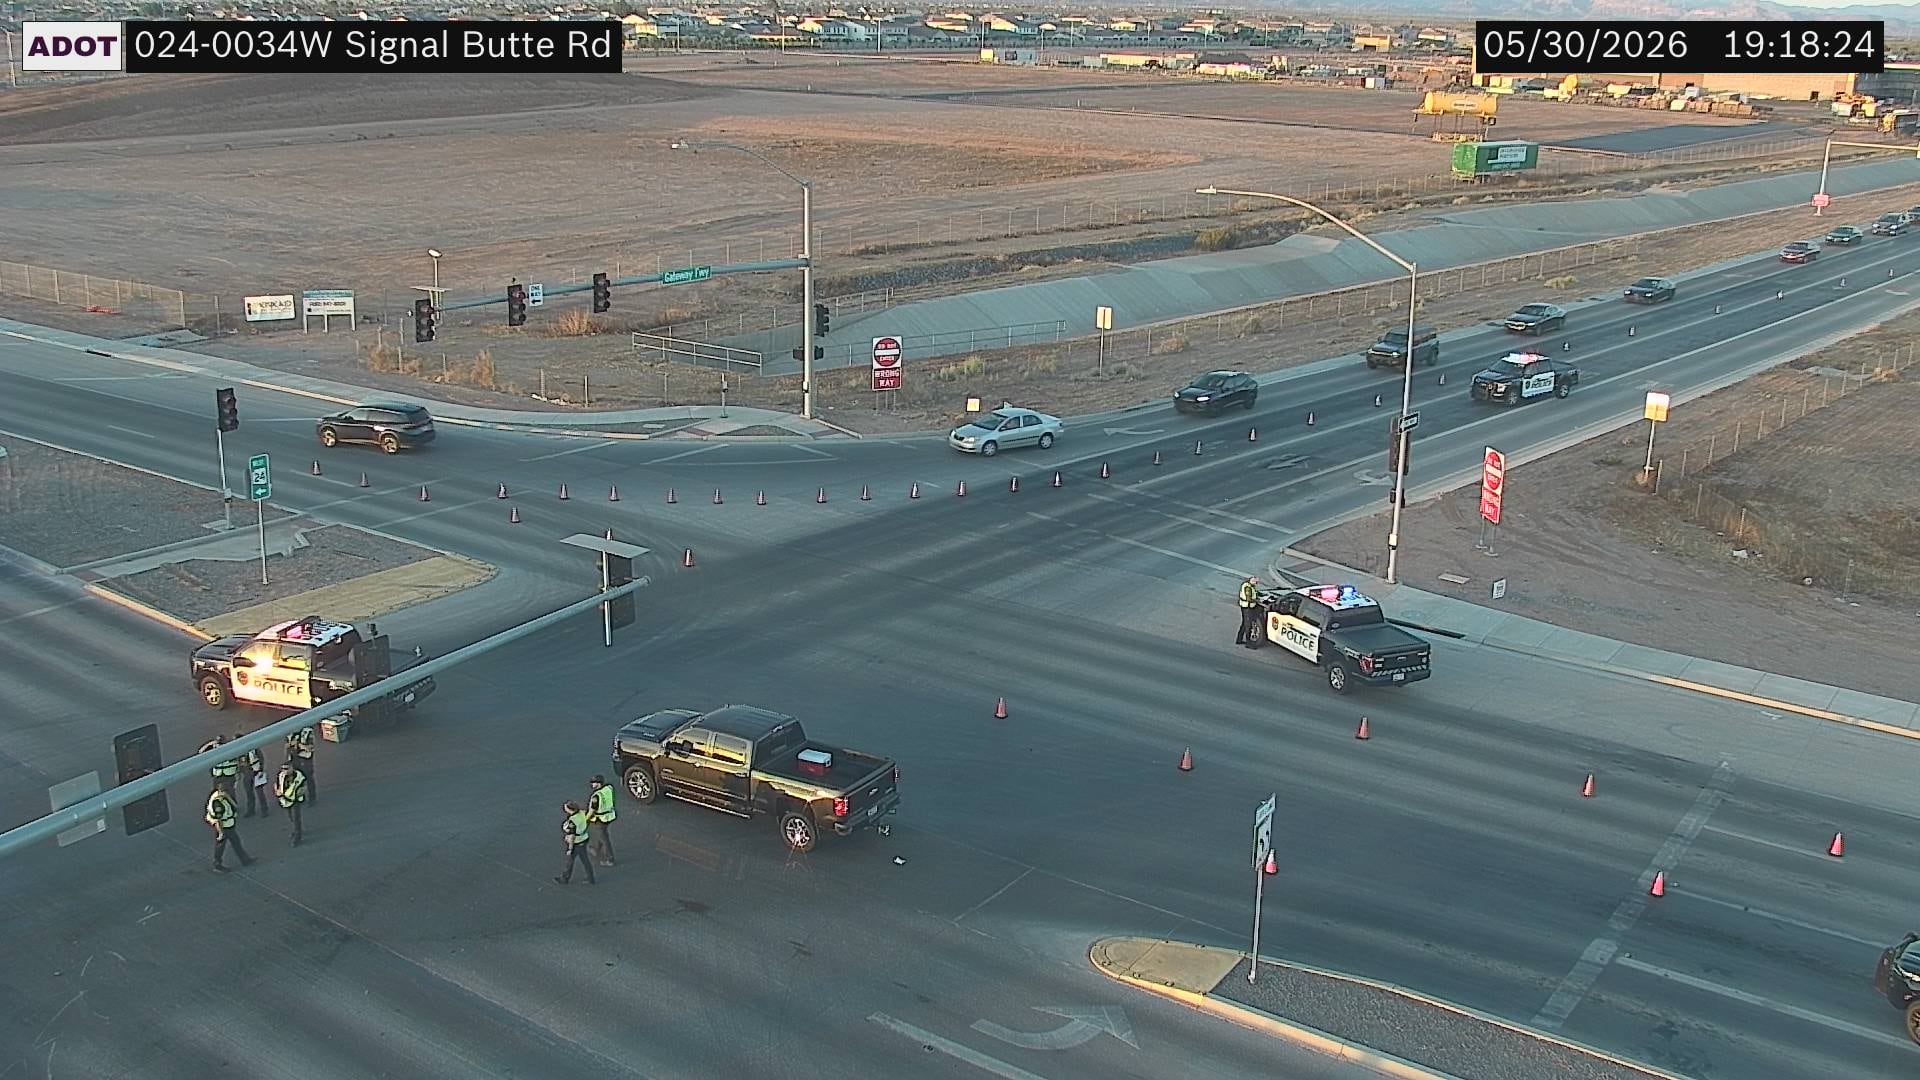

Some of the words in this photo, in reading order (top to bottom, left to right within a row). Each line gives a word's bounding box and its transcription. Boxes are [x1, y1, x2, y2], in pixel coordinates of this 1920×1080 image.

[879, 379, 895, 387] WAY
[254, 471, 266, 483] 24
[1280, 626, 1316, 652] POLICE
[254, 679, 304, 696] POLICE
